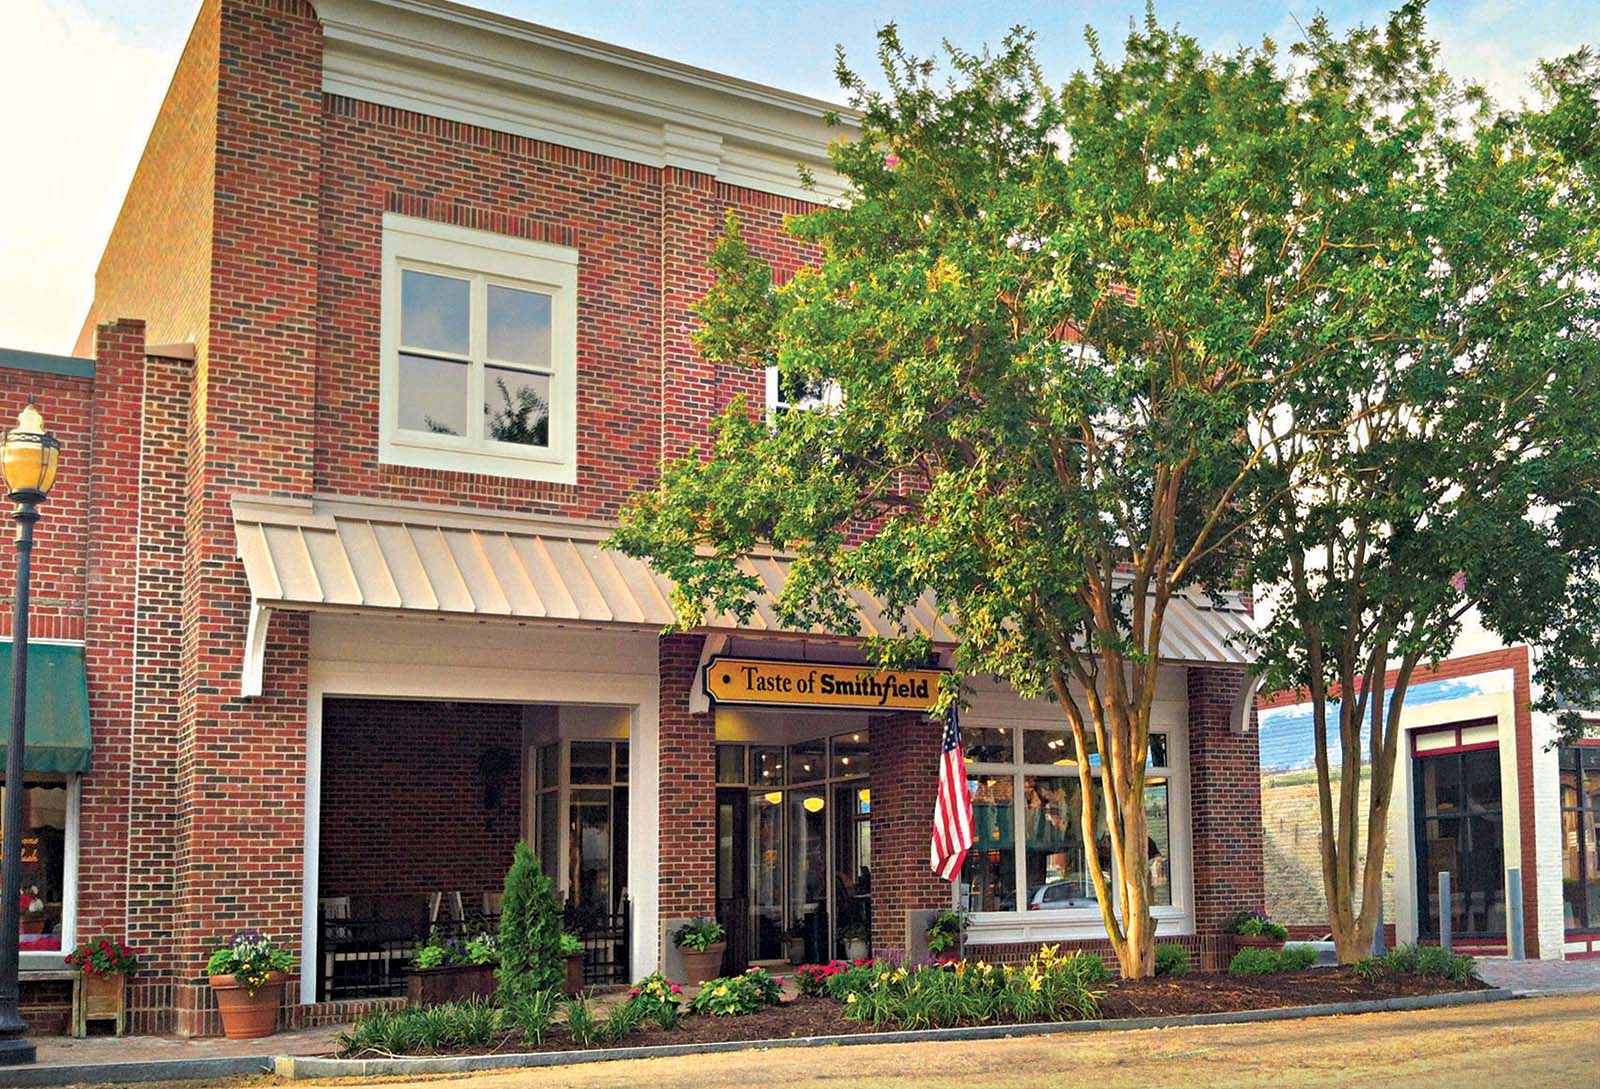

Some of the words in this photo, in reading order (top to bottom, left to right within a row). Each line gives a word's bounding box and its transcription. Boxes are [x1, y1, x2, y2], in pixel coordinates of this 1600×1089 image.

[741, 666, 792, 692] Taste
[797, 670, 817, 693] of
[821, 674, 929, 705] Smithfield
